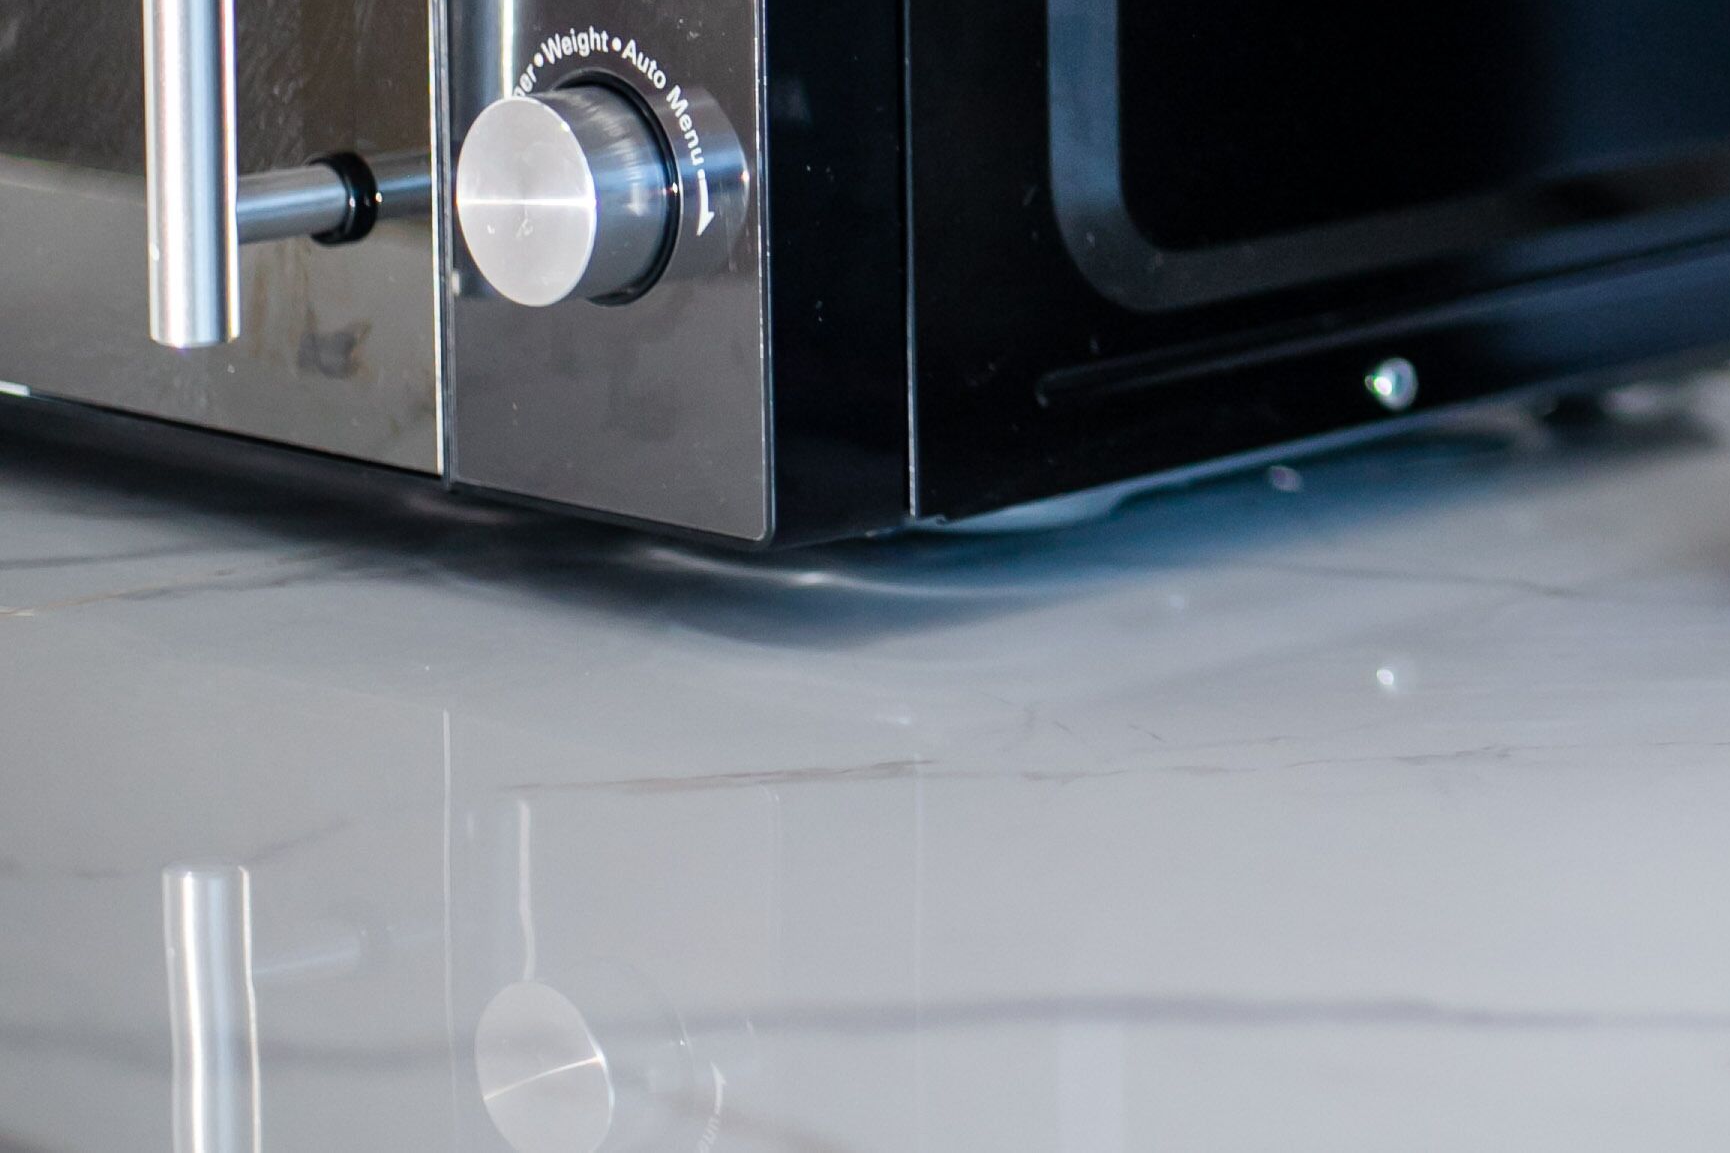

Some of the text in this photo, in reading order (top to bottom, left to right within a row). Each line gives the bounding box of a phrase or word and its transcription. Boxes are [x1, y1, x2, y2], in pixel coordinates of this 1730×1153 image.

[541, 26, 609, 65] Weight
[624, 39, 667, 90] Auto
[666, 84, 705, 166] Menu
